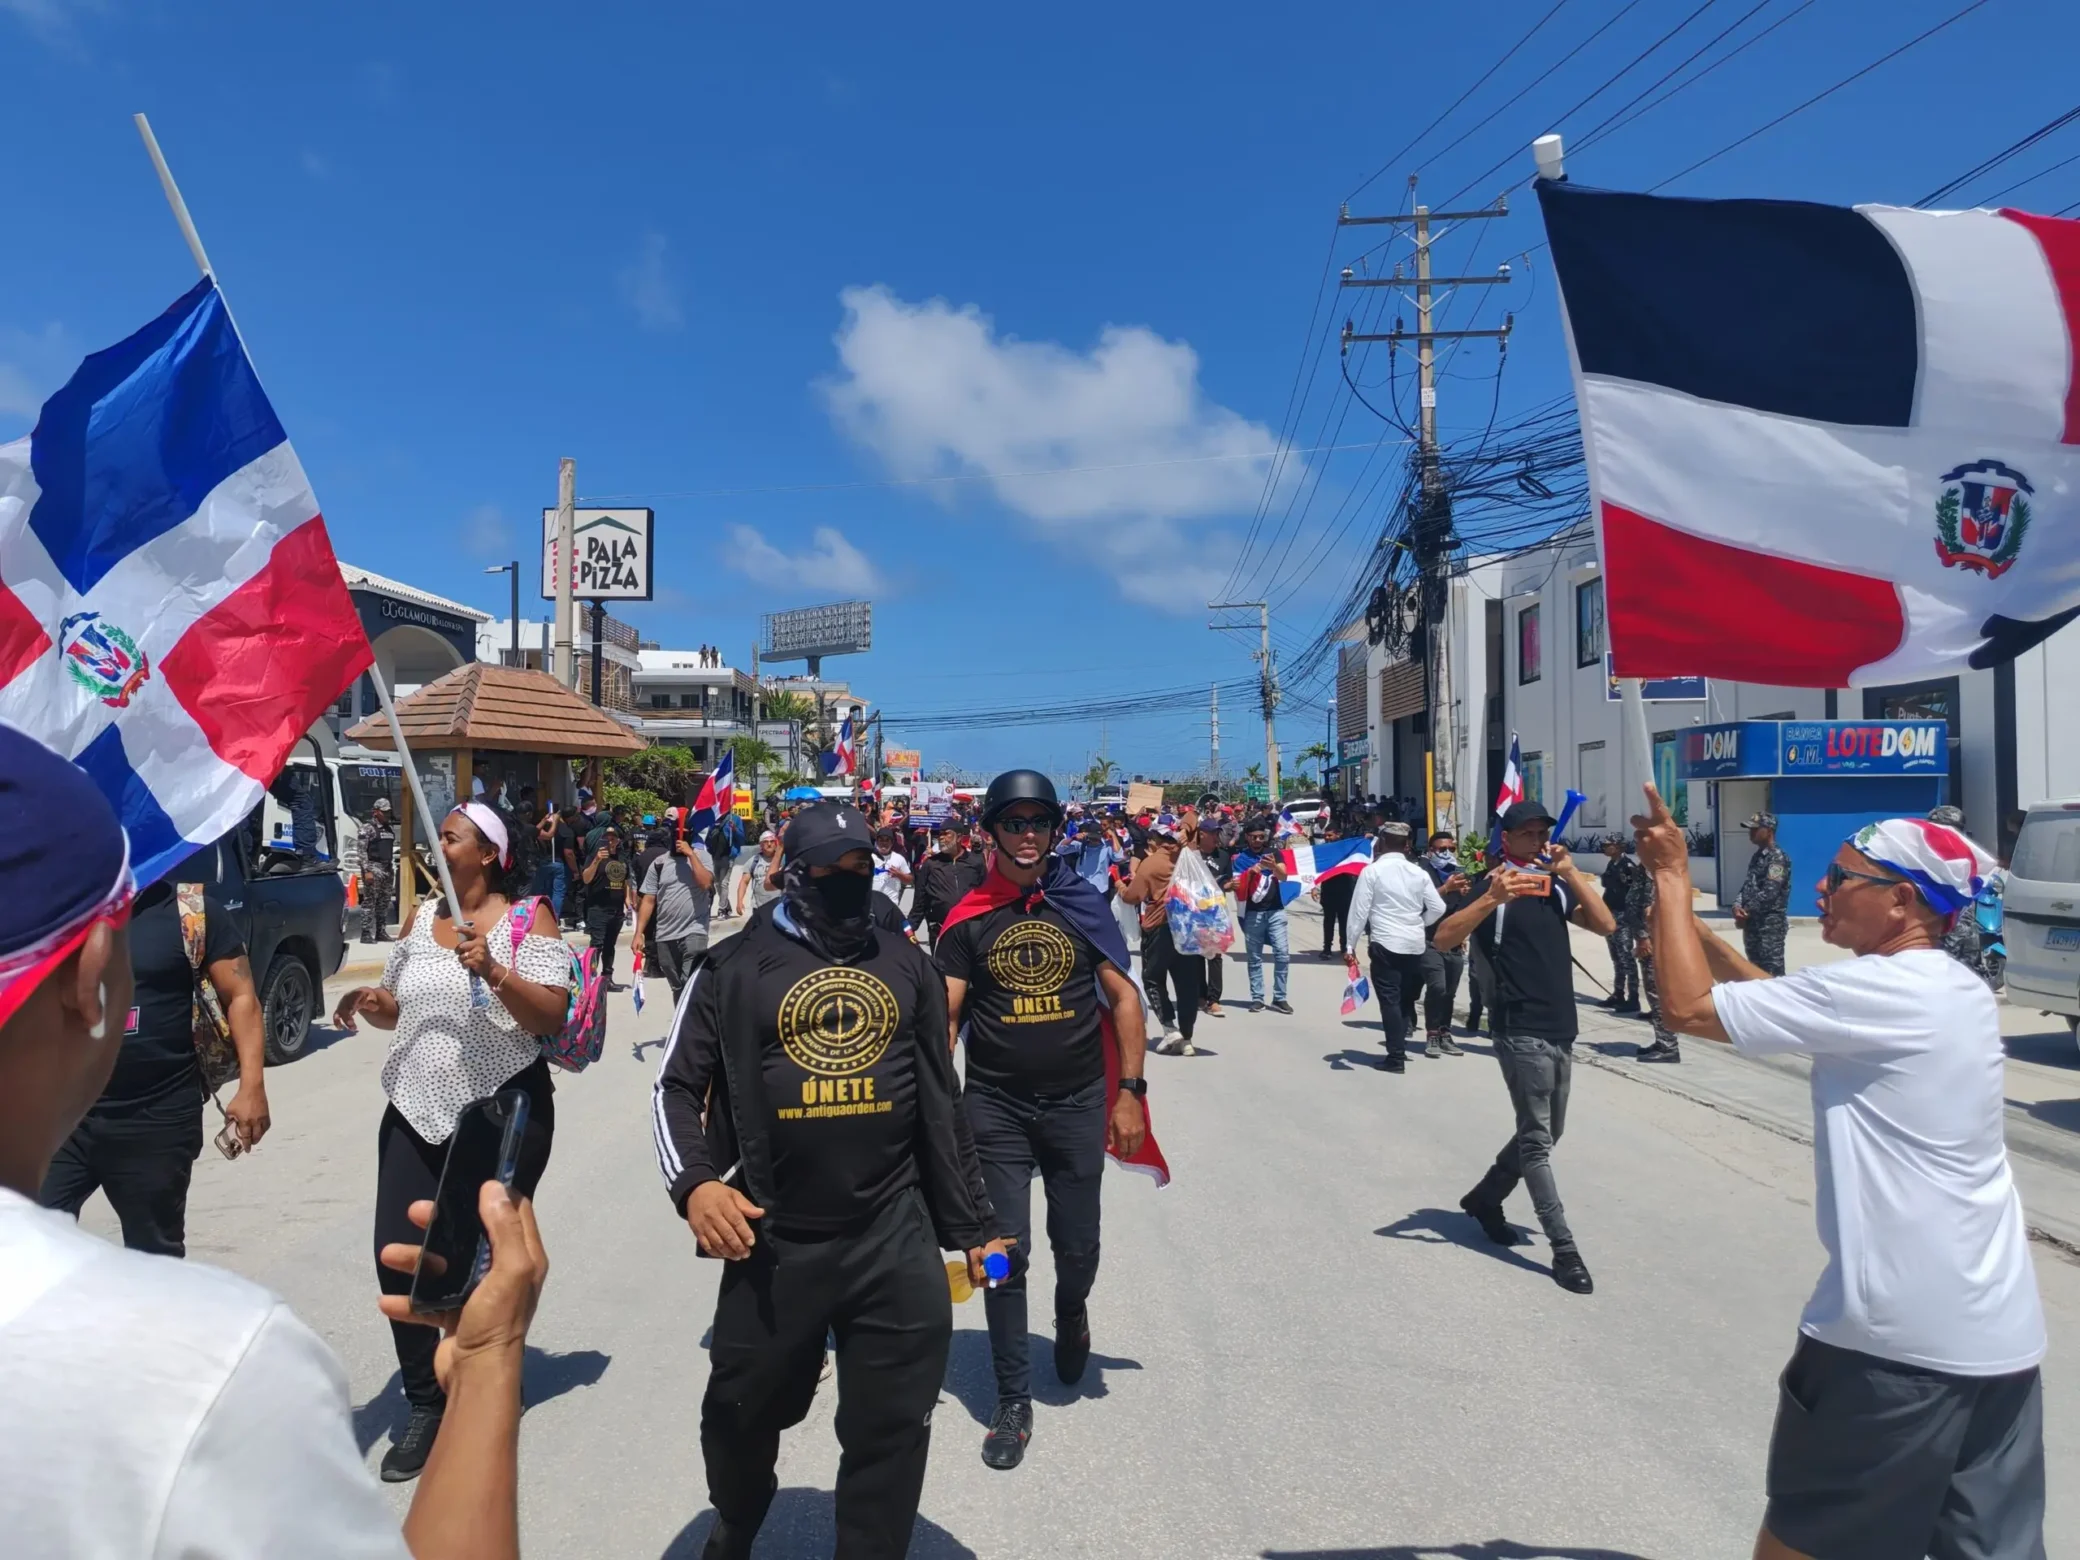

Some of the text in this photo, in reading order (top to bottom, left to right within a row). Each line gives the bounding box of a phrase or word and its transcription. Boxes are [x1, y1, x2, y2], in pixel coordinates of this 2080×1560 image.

[587, 535, 638, 565] PALA
[398, 606, 437, 626] GLAMOUR
[1786, 727, 1823, 741] BANCA
[1827, 727, 1935, 757] LOTEDOM
[799, 983, 881, 1020] ANTIGUA ORDEN DOMINICANA
[801, 1032, 828, 1055] DEFENSA
[843, 1047, 854, 1055] LA
[802, 1075, 875, 1105] ÚNETE
[777, 1100, 893, 1120] www.antiguaorden.com
